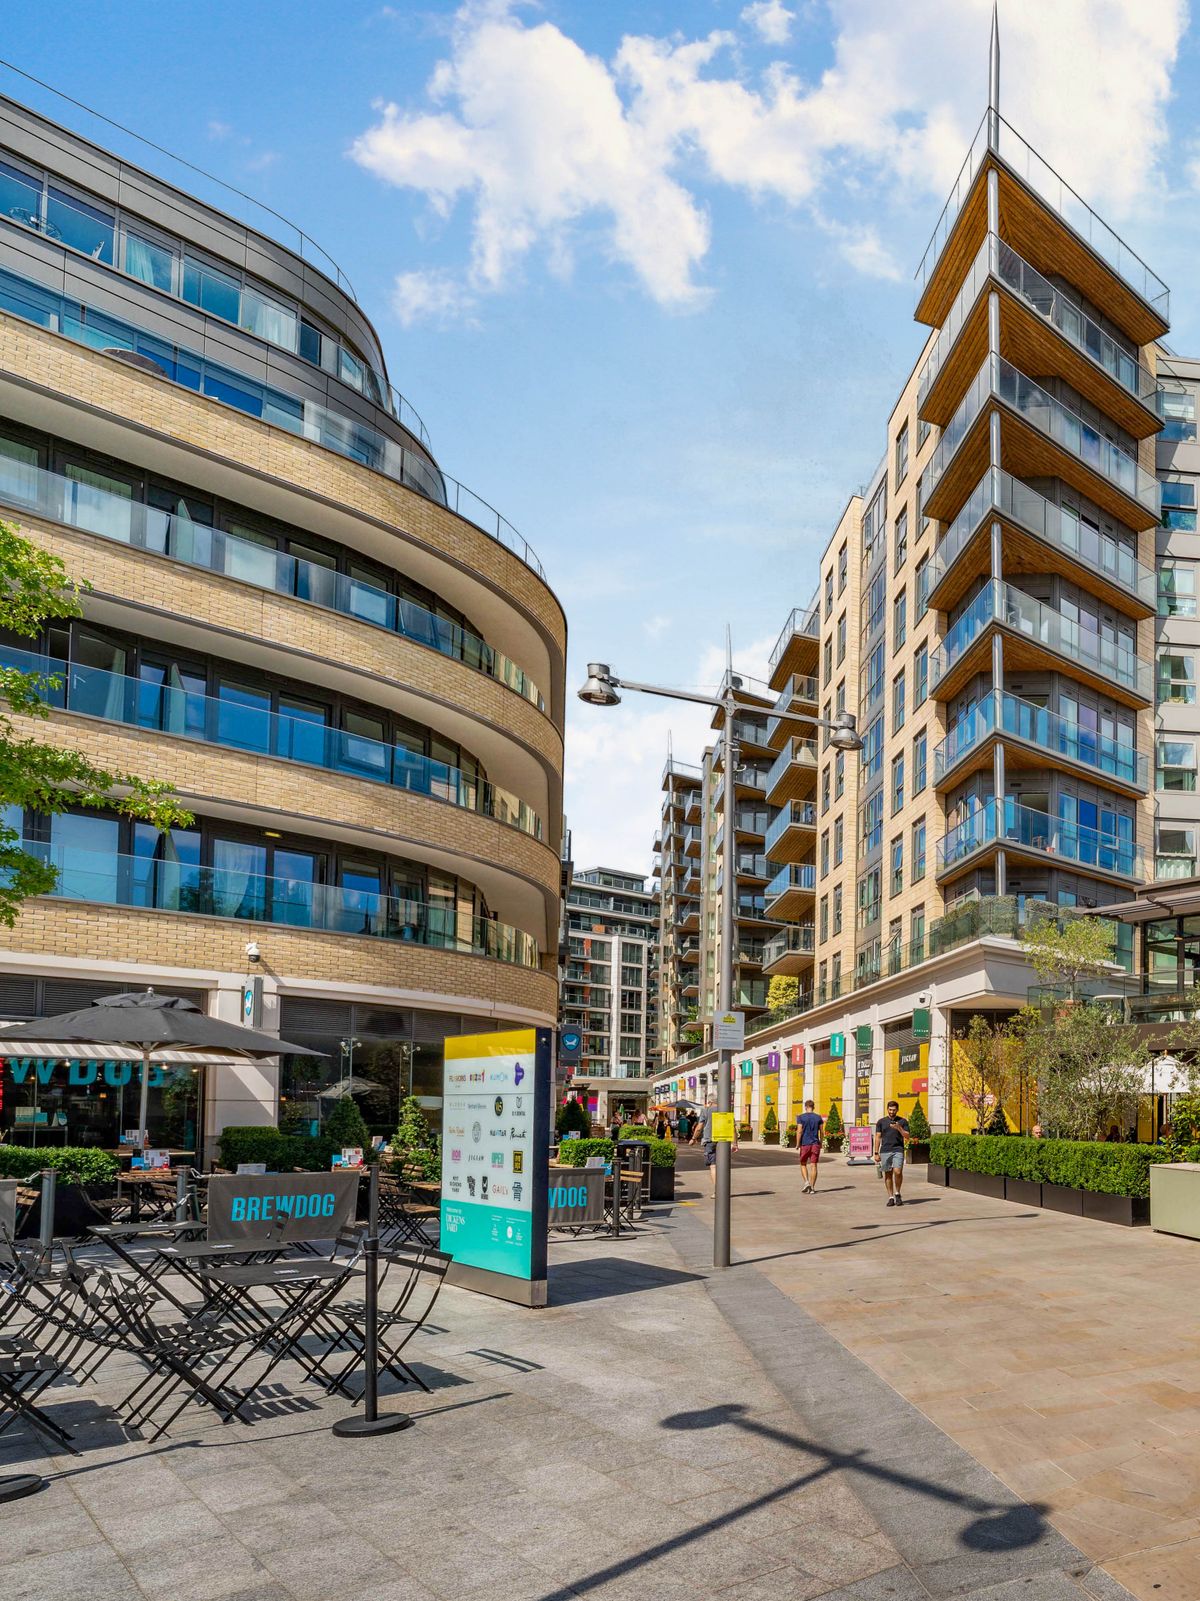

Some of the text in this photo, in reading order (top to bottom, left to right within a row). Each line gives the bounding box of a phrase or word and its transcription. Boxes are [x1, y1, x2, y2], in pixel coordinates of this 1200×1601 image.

[901, 1054, 917, 1065] JIGSAW
[231, 1193, 335, 1222] BREWDOG
[446, 1214, 465, 1225] DICKENS
[446, 1224, 458, 1232] YARD
